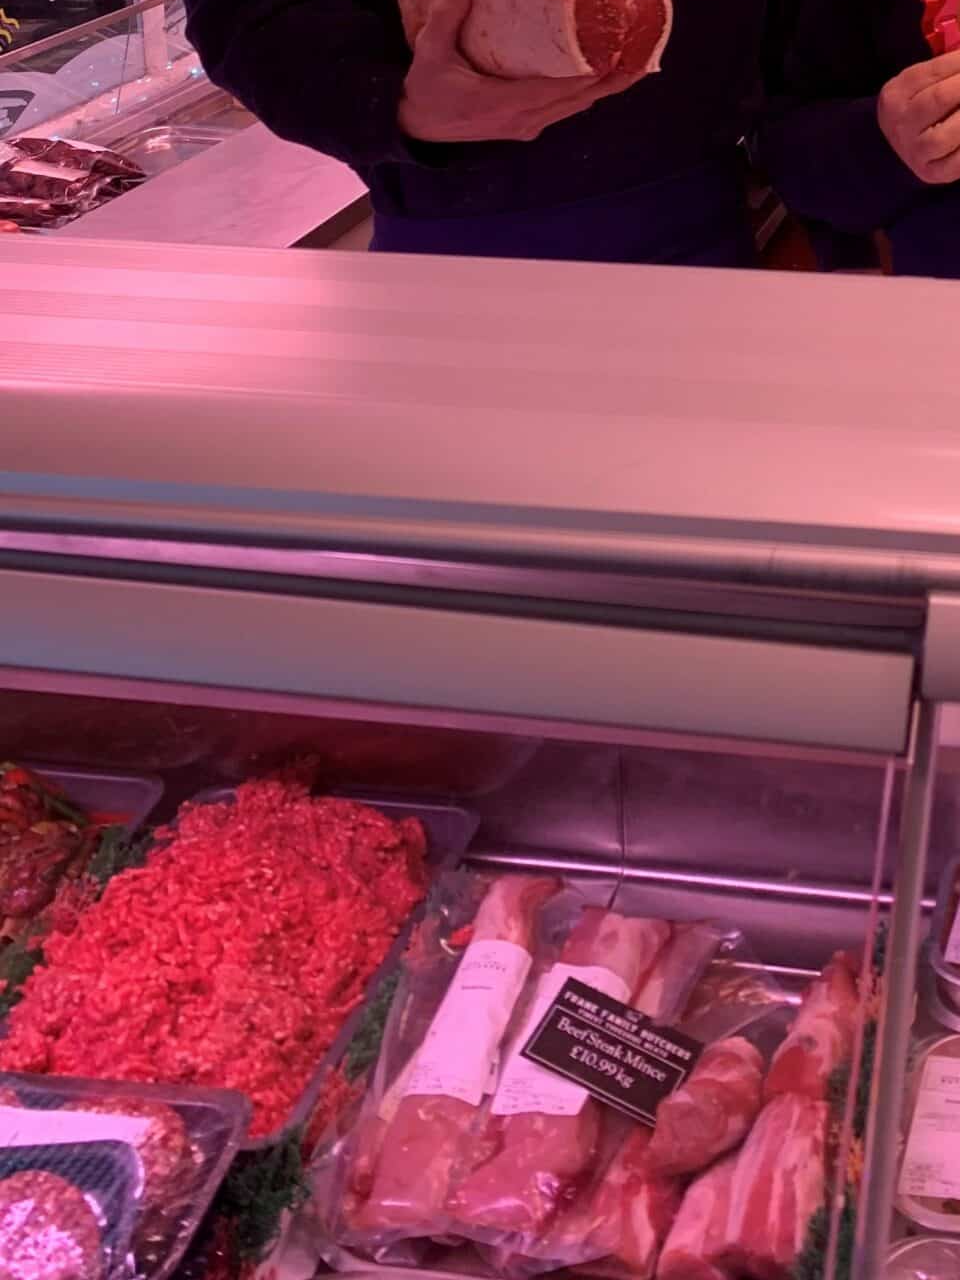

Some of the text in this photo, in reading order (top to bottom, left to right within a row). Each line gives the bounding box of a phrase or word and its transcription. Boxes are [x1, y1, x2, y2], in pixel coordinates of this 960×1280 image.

[556, 1016, 587, 1042] Beef
[587, 1030, 624, 1061] Steak
[624, 1050, 667, 1083] Mince
[569, 1045, 617, 1076] £10.99
